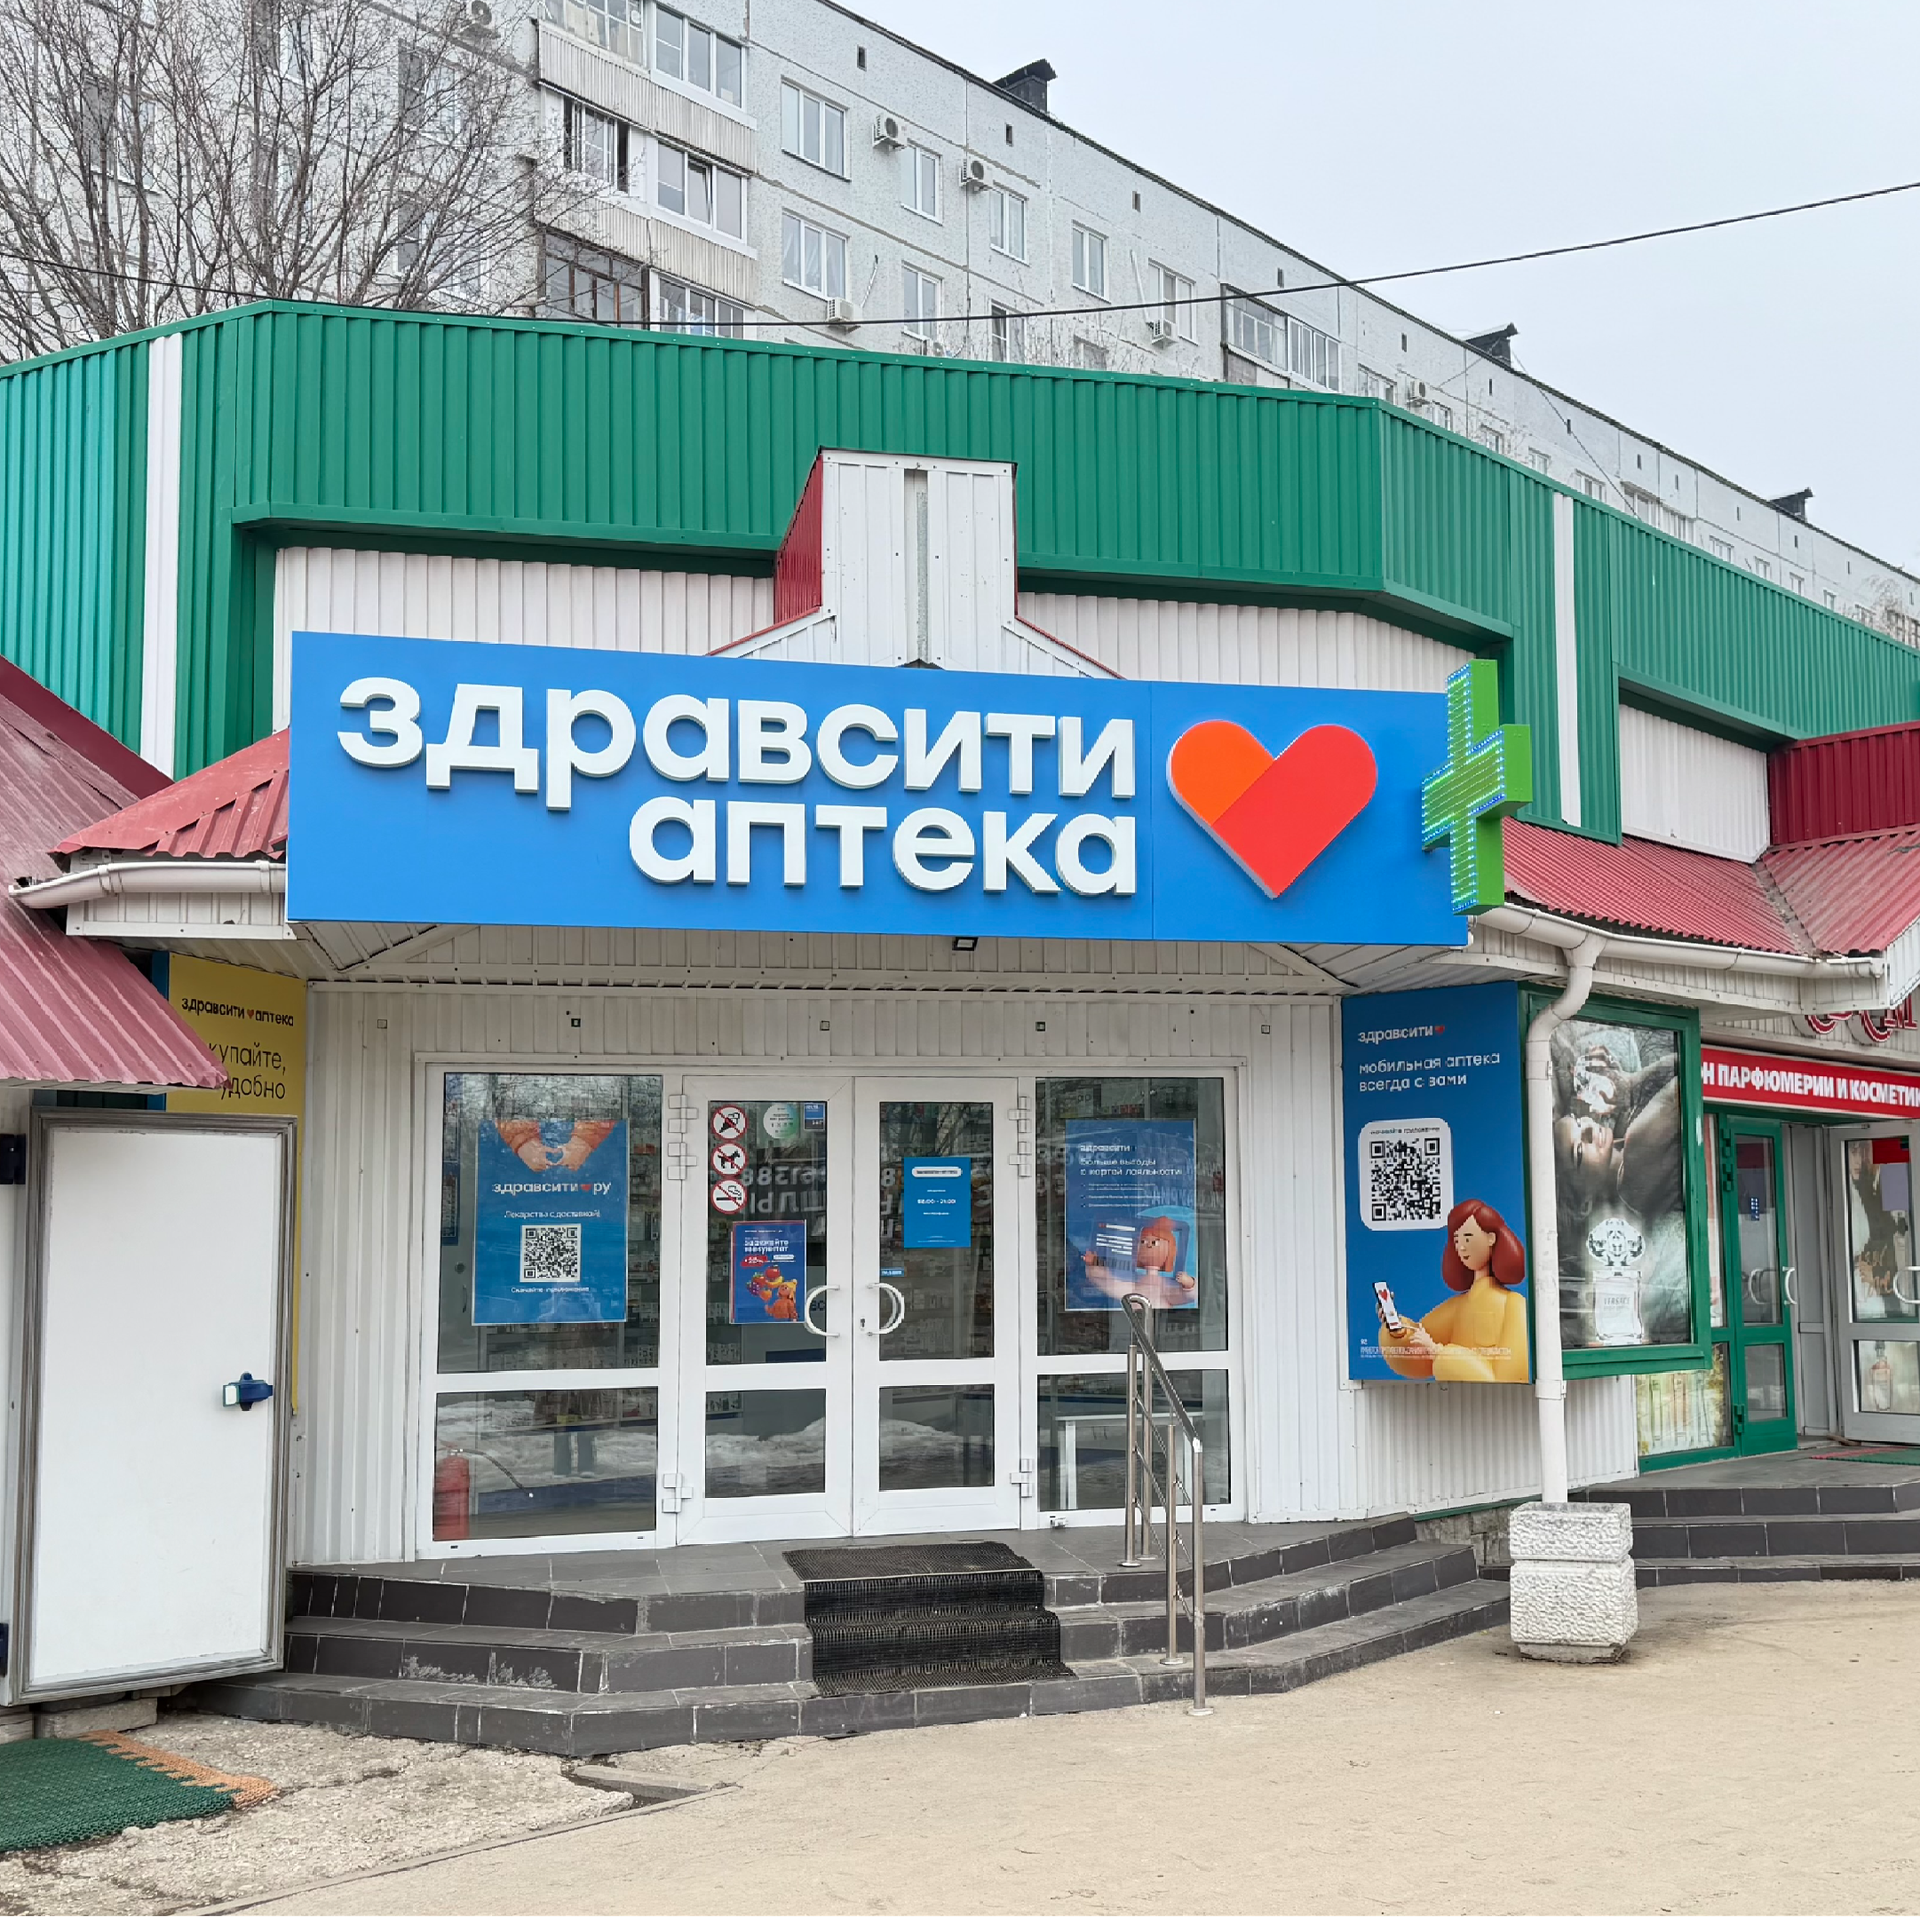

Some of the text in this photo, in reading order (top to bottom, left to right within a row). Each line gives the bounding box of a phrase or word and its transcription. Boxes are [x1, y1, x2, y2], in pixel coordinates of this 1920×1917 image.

[337, 676, 1137, 811] здравсити
[628, 796, 1137, 896] аптека
[181, 998, 294, 1026] здравсити аптека
[1357, 1025, 1433, 1044] здравсити
[1359, 1052, 1500, 1074] мобильная аптека
[1359, 1077, 1410, 1092] всегда
[1414, 1077, 1424, 1088] с
[1718, 1063, 1833, 1099] ПАРФЮМЕРИИ
[1837, 1076, 1848, 1100] И
[492, 1181, 612, 1196] здравсити ру
